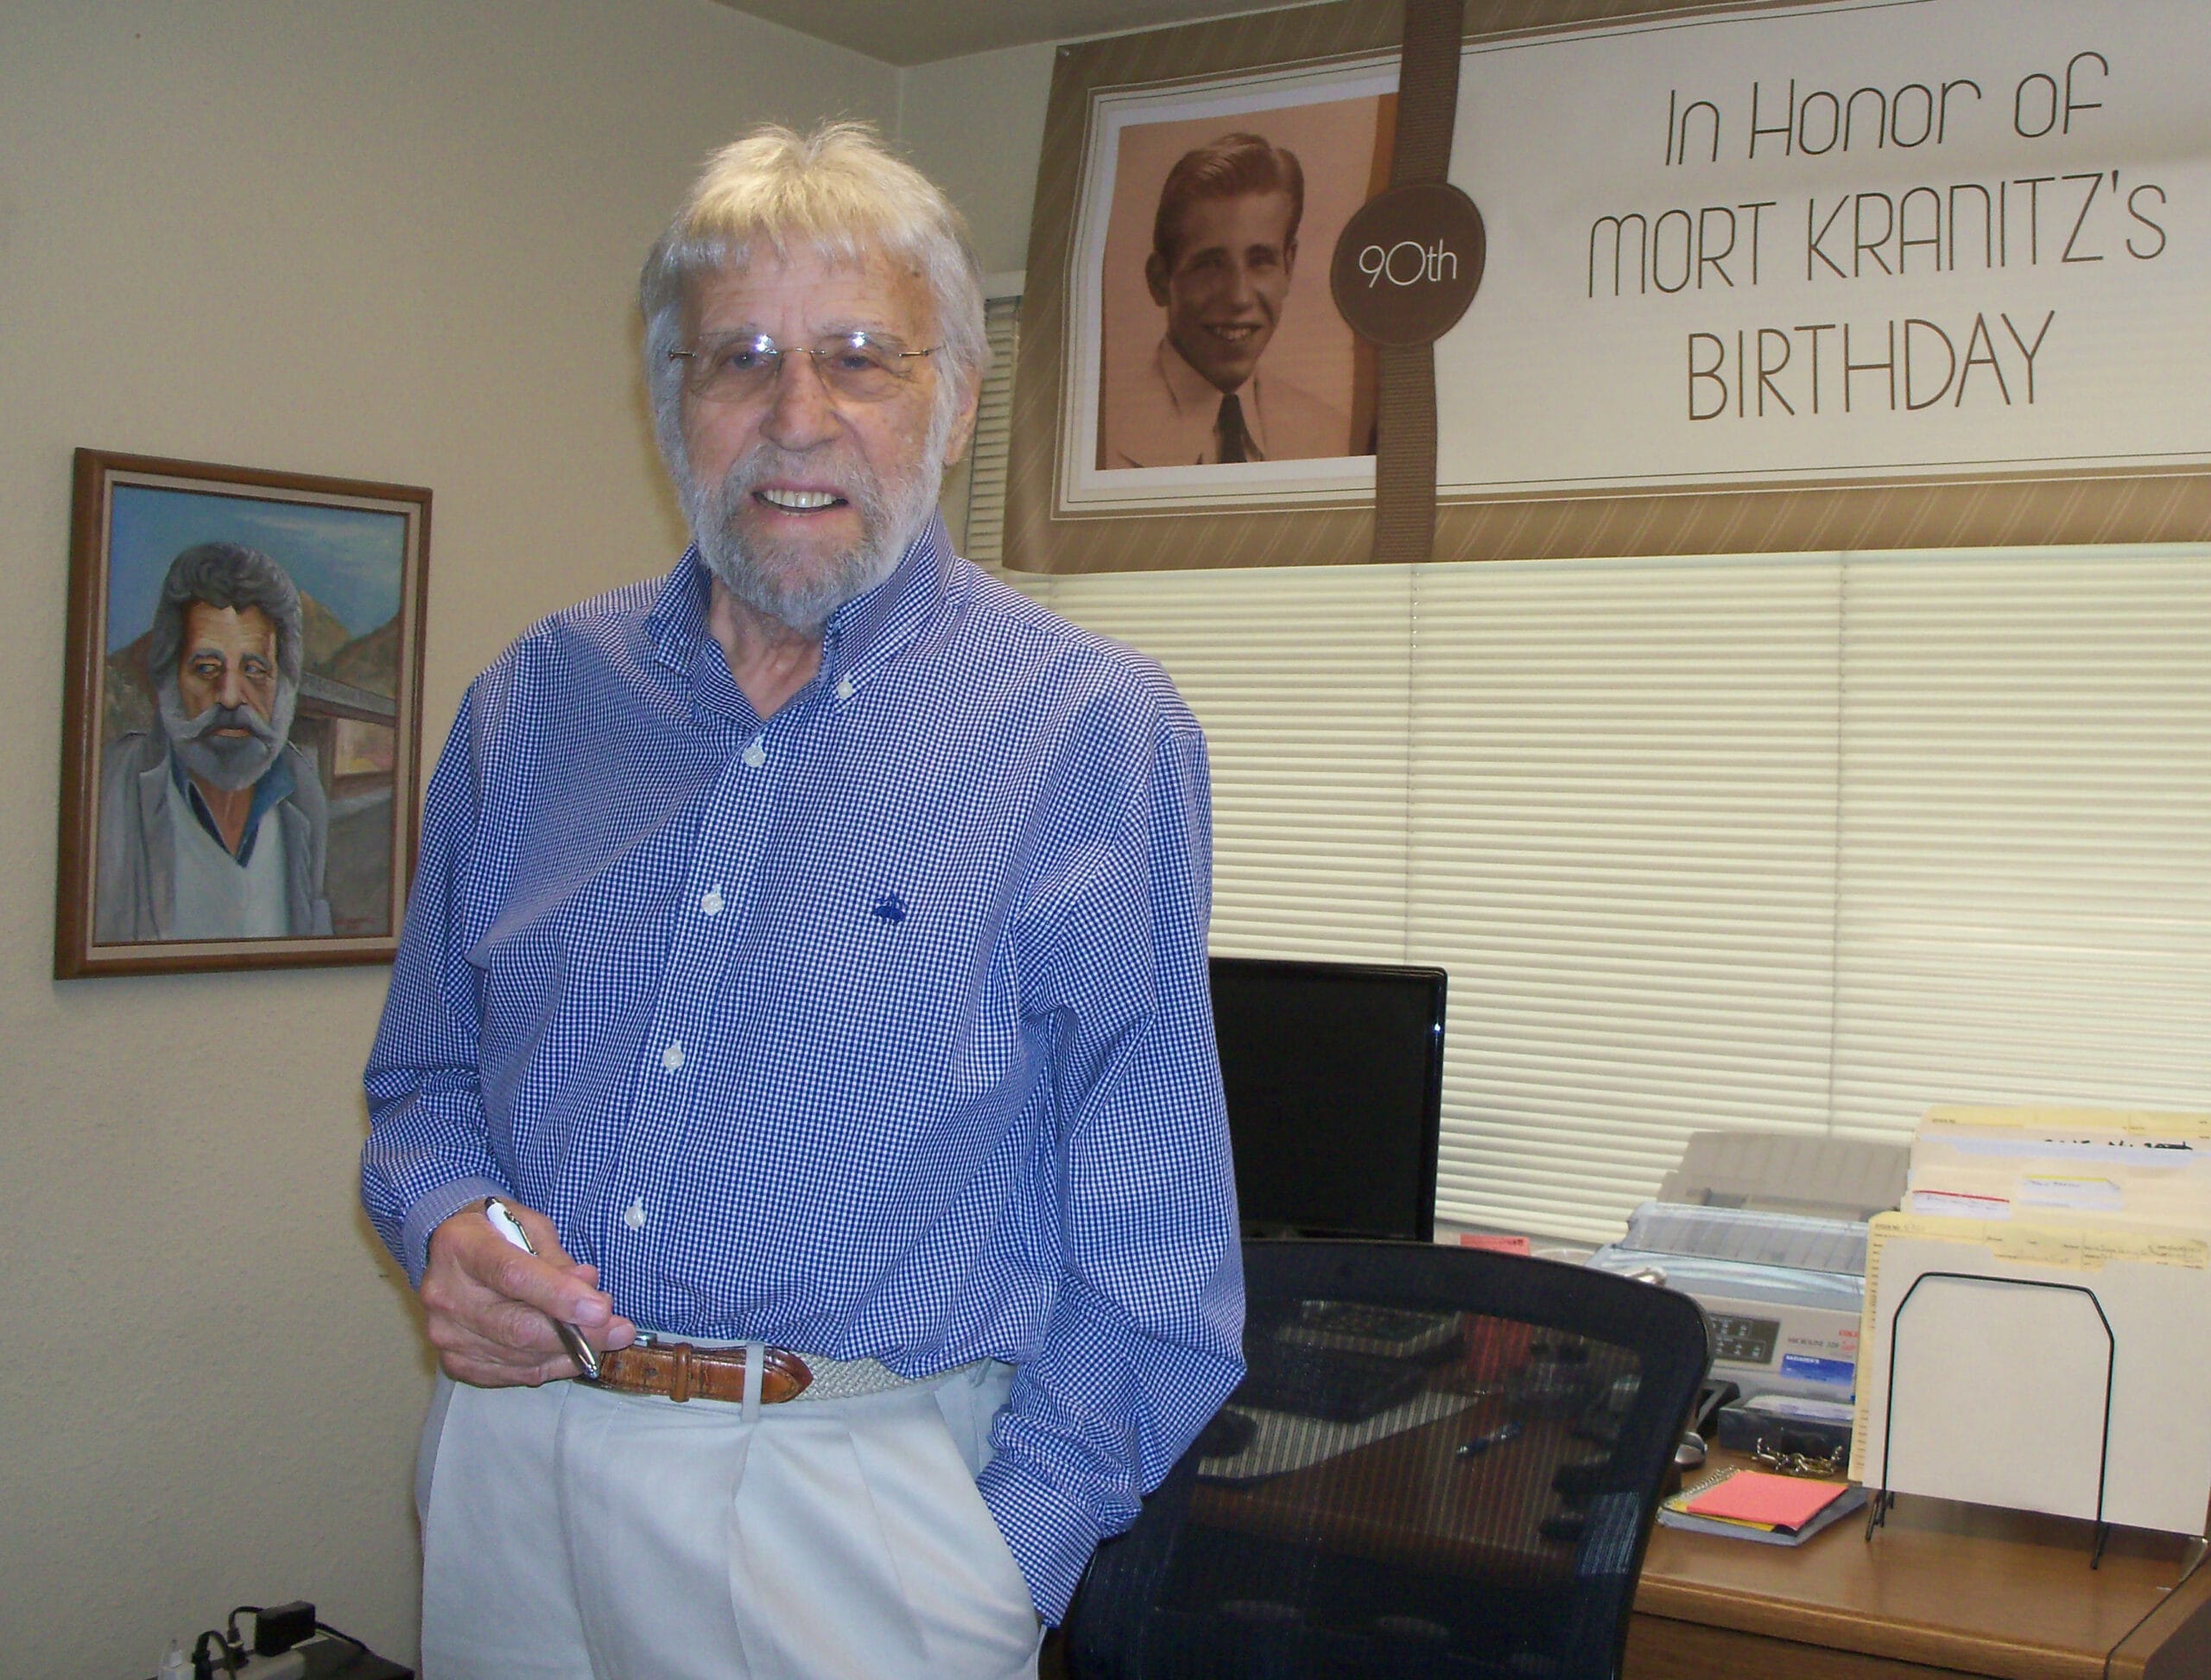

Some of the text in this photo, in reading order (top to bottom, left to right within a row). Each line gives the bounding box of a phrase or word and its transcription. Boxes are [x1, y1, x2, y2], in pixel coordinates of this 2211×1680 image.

[1665, 51, 2109, 167] In Honor of
[1359, 238, 1458, 288] 90th
[1588, 201, 1777, 299] MORT
[1688, 309, 2056, 422] BIRTHDAY
